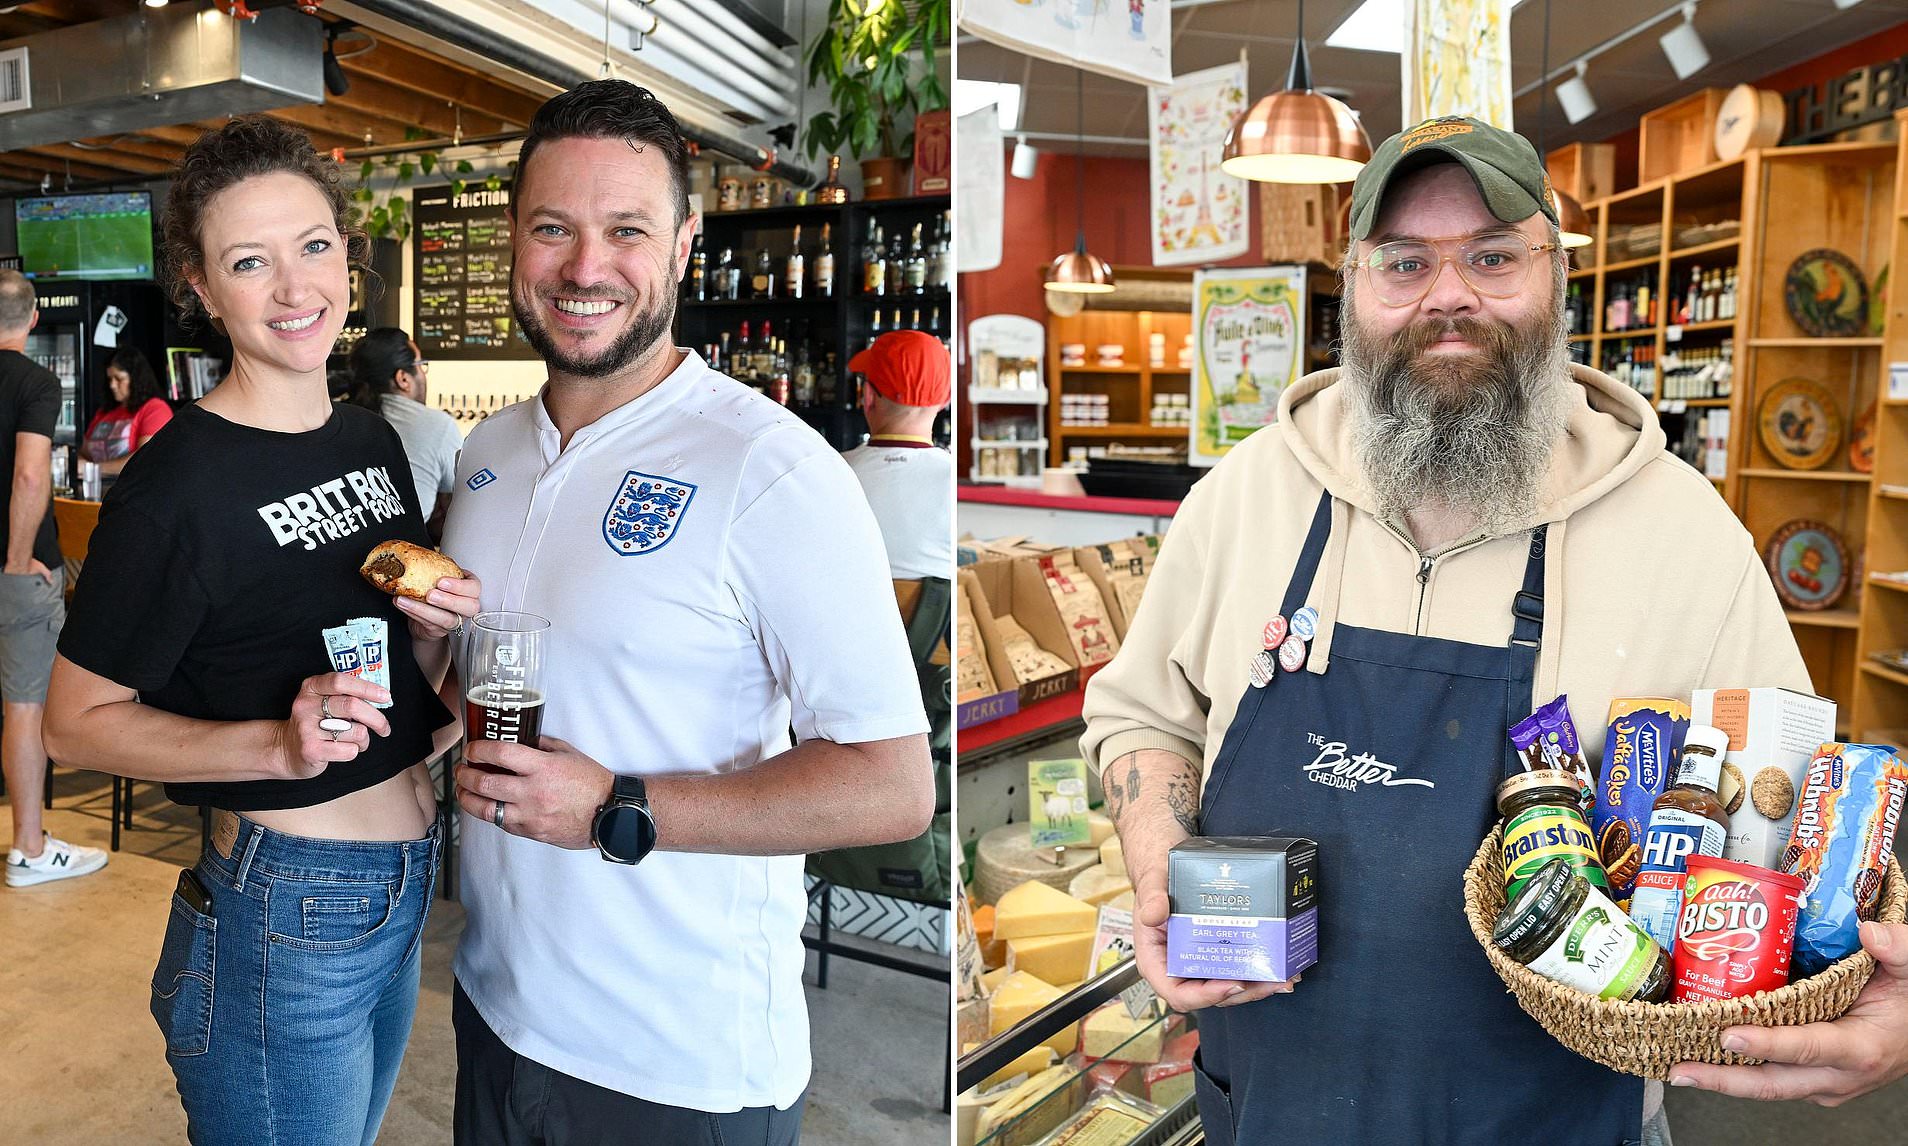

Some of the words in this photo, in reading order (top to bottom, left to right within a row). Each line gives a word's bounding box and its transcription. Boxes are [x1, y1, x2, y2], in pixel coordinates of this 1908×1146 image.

[453, 189, 509, 209] FRICTION
[257, 477, 352, 547] BRIT
[297, 505, 368, 551] STREET
[334, 652, 357, 670] HP
[486, 681, 501, 719] BEER
[1032, 675, 1069, 701] JERKY
[500, 665, 525, 744] FRICTIO
[962, 696, 1006, 725] JERKY
[1307, 732, 1325, 746] THE
[1613, 720, 1636, 765] Jaffa
[1303, 742, 1434, 789] Better
[1641, 730, 1657, 785] McVitie's
[1308, 769, 1358, 793] CHEDDAR
[1606, 764, 1631, 807] Cakes
[1795, 753, 1833, 849] Hobnobs
[1657, 814, 1686, 823] ORIGINAL
[1503, 823, 1596, 872] Branston
[1641, 830, 1695, 867] HP
[1538, 889, 1557, 912] EASY
[1551, 875, 1566, 893] OPEN
[1642, 874, 1674, 886] SAUCE
[1703, 880, 1760, 902] aah!
[1199, 894, 1251, 906] TAYLORS
[1192, 928, 1214, 937] EARL
[1216, 930, 1238, 938] GREY
[1240, 931, 1257, 939] TEA
[1509, 925, 1528, 941] OPEN
[1523, 914, 1537, 928] LID
[1568, 910, 1600, 953] DUERR'S
[1680, 900, 1769, 939] BISTO
[1180, 953, 1209, 961] NATURAL
[1587, 924, 1623, 974] MINT
[1620, 957, 1641, 984] SAUCE
[1685, 968, 1700, 981] For
[1702, 973, 1727, 987] Beef
[1678, 978, 1697, 988] GRAVY
[1698, 982, 1732, 998] GRANULES
[1686, 990, 1701, 1002] NET
